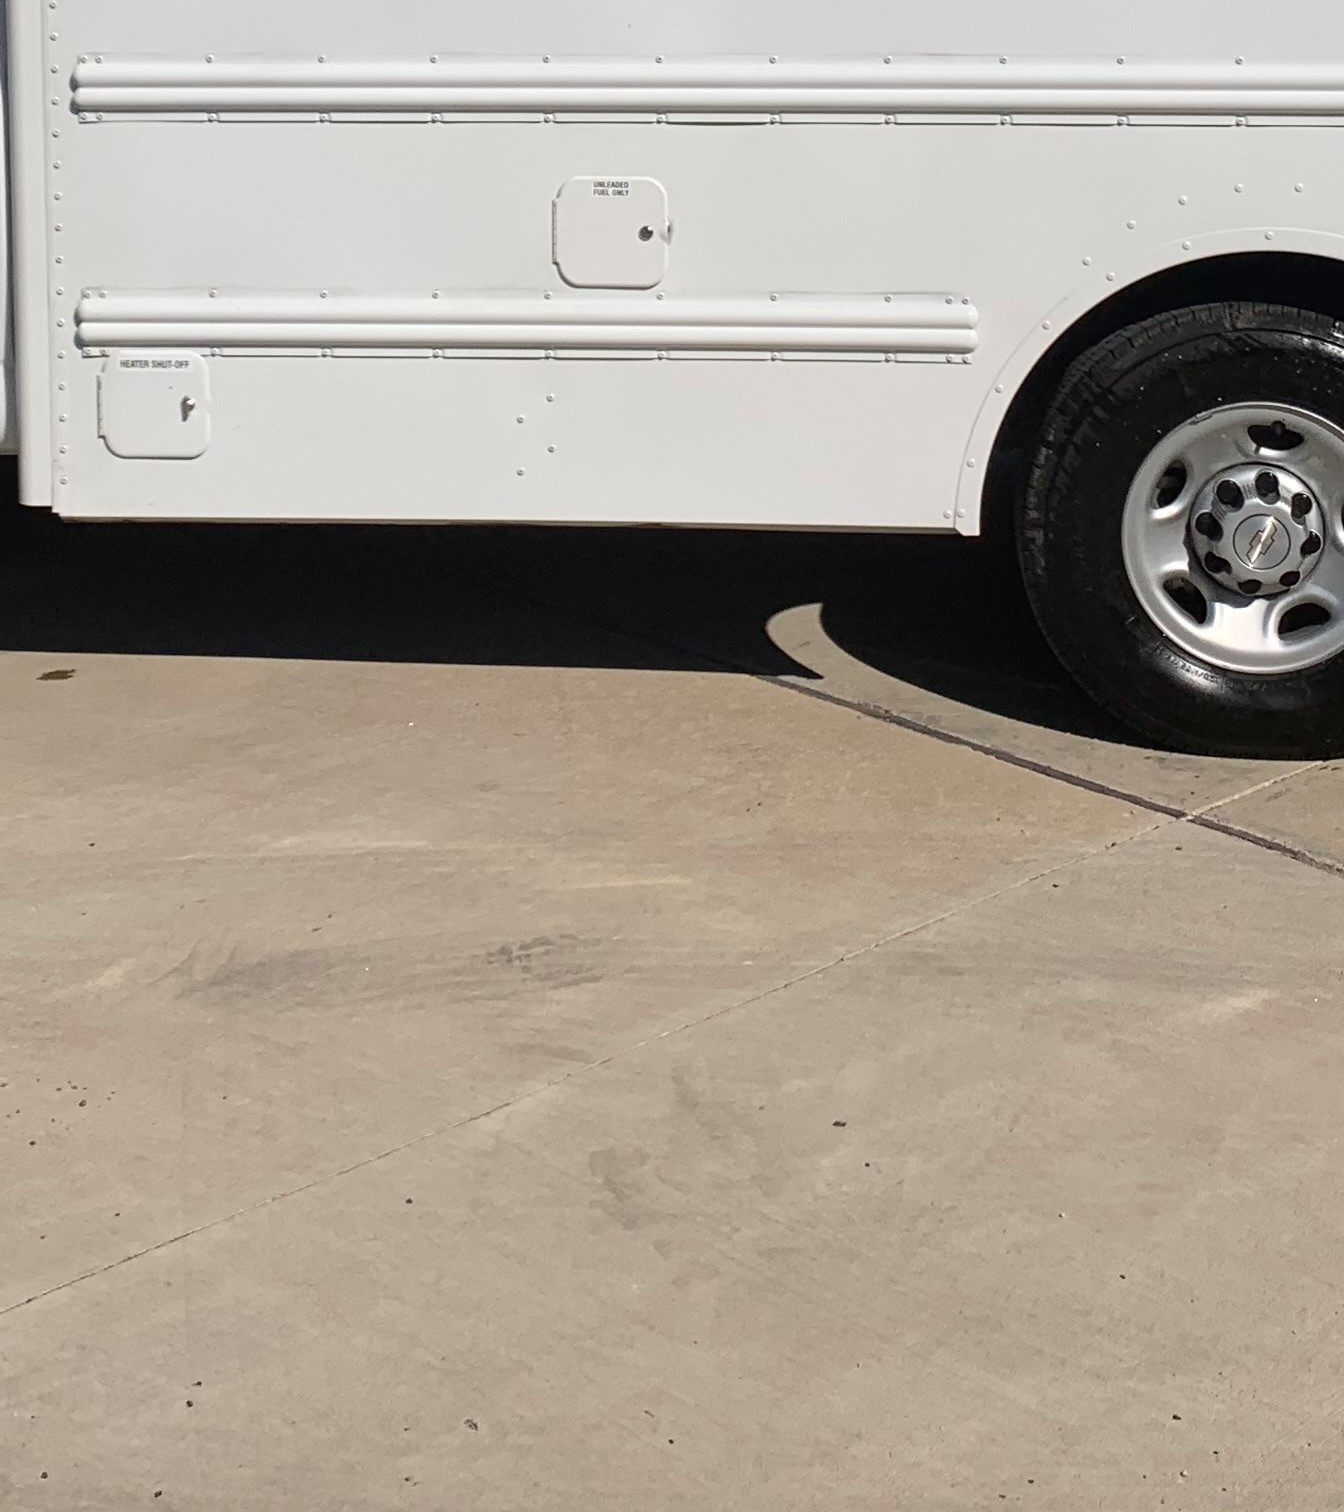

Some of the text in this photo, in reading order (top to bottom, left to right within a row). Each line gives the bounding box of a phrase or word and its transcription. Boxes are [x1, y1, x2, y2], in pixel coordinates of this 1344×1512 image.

[593, 181, 629, 189] UNLEADED
[612, 189, 629, 197] ONLY
[120, 360, 190, 368] HEATER SHUT-OFF
